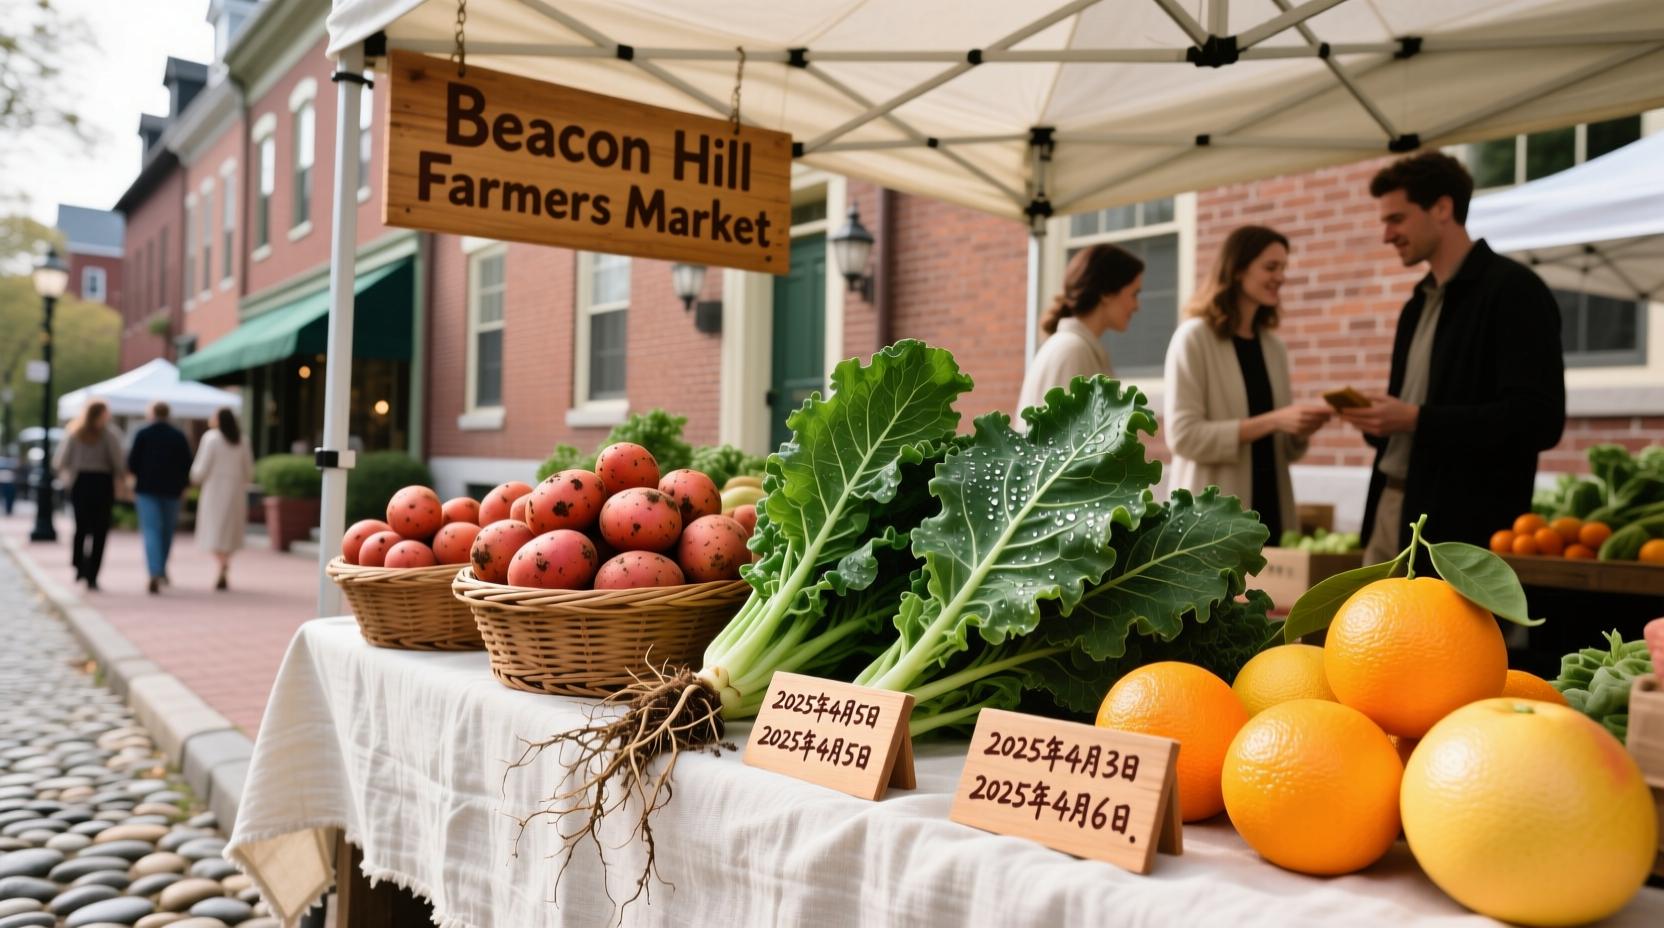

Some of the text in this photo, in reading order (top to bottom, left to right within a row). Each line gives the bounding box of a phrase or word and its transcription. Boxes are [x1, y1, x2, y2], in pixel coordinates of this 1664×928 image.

[446, 81, 751, 192] Beacon Hill
[418, 150, 771, 248] Farmers Market
[772, 690, 881, 729] 2025年4月5日
[757, 725, 872, 770] 2025年4月5日
[983, 731, 1140, 782] 2025年4月3日
